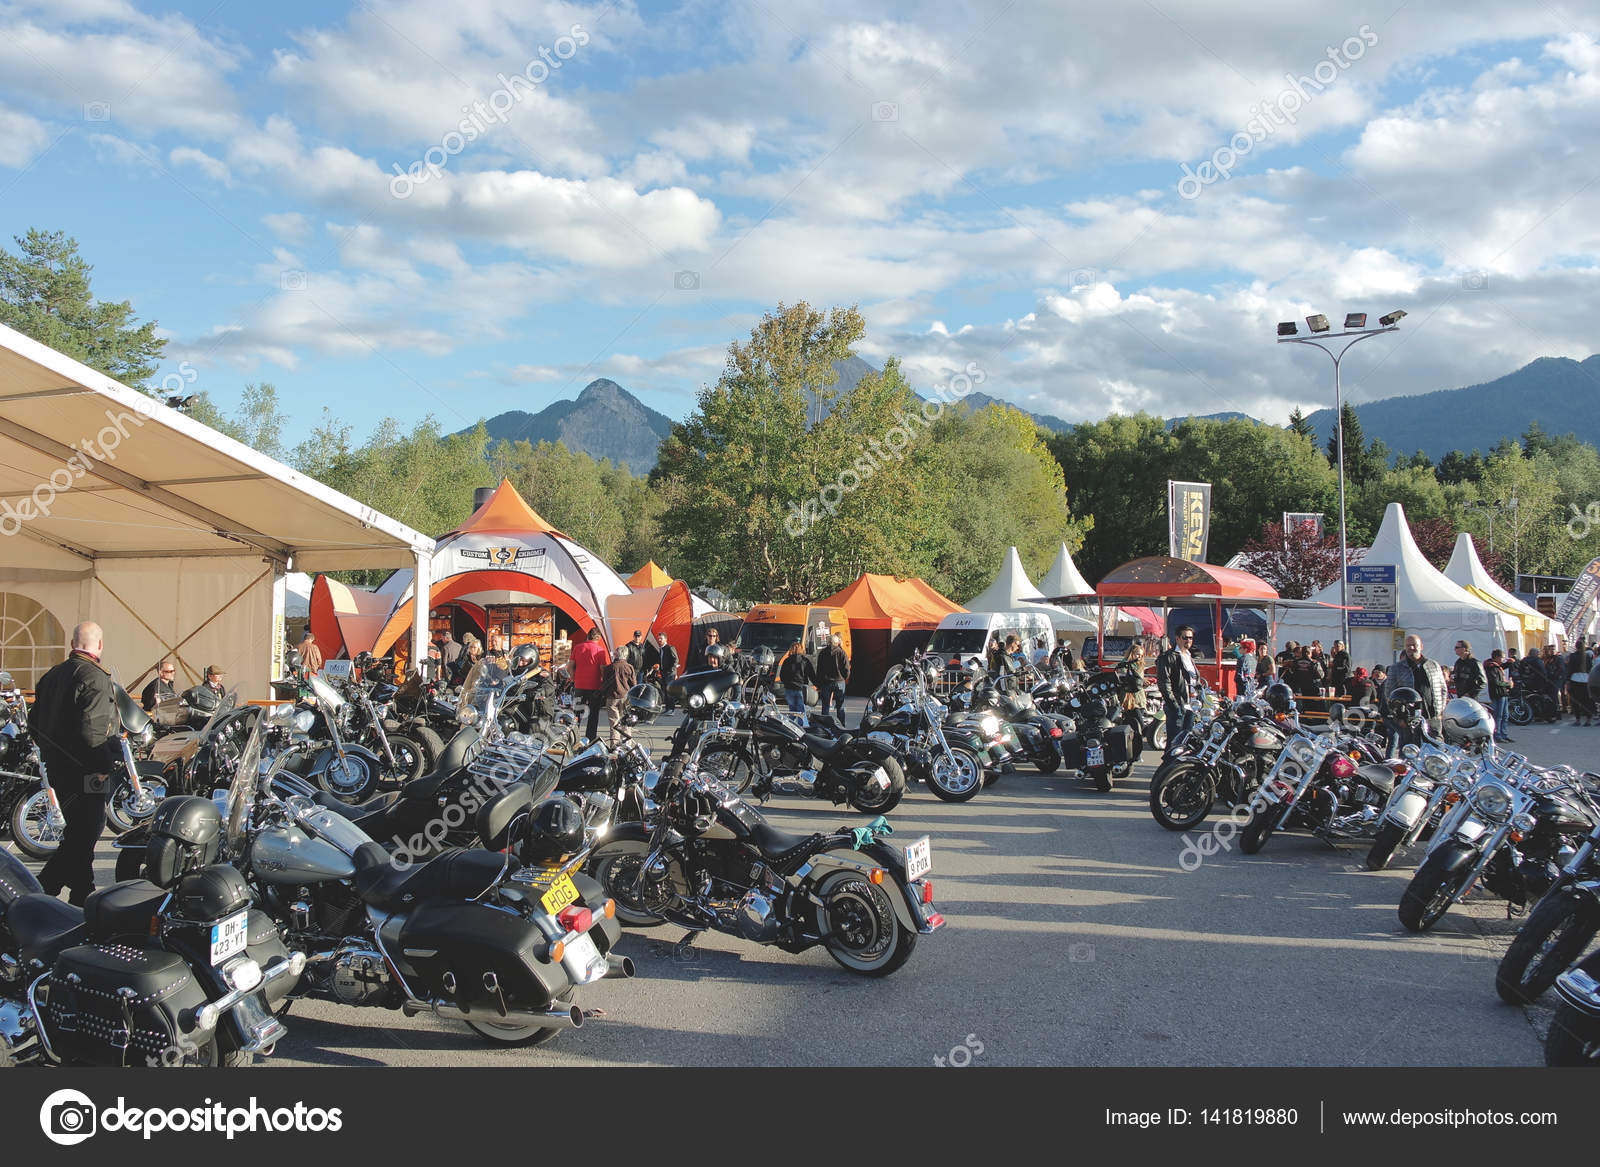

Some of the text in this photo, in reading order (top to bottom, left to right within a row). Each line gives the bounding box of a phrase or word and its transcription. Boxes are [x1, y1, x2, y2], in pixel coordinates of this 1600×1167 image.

[462, 550, 488, 558] CUSTOM
[913, 846, 920, 858] W
[547, 884, 573, 911] HOG
